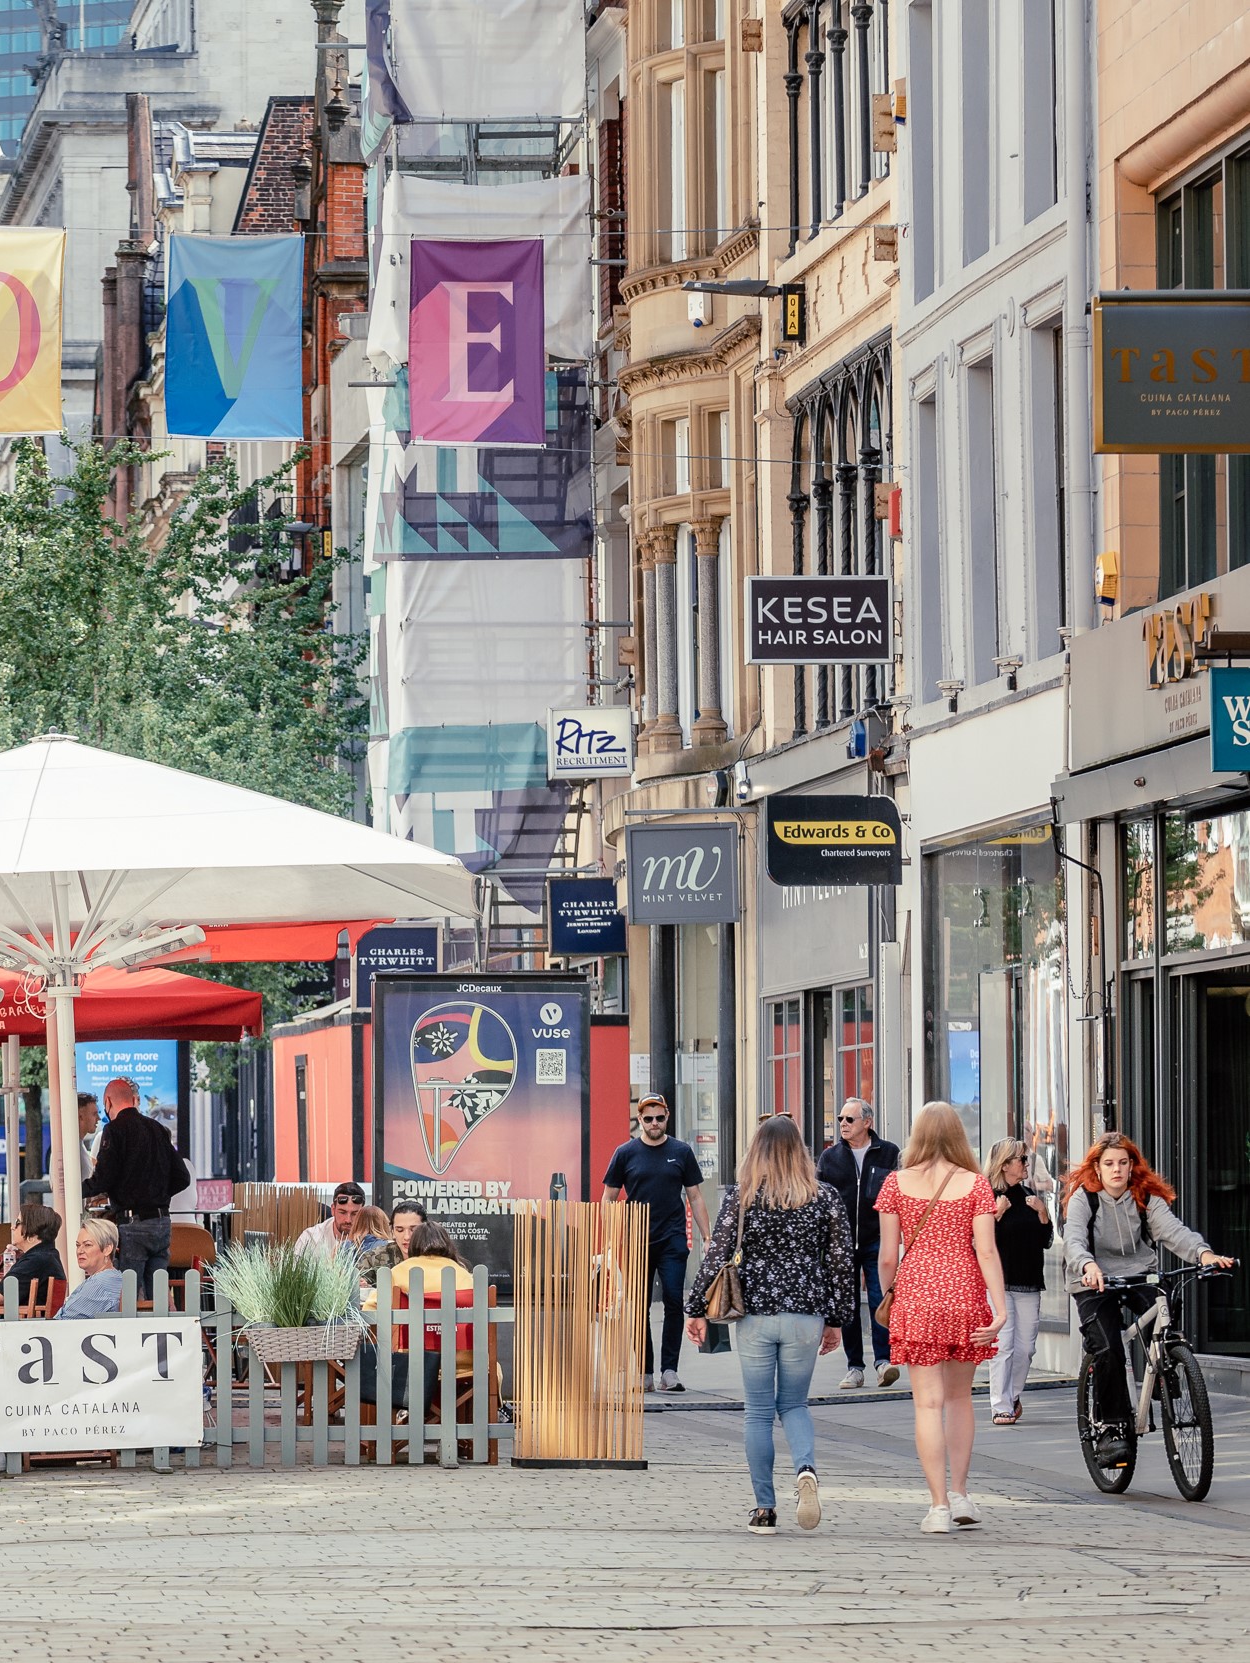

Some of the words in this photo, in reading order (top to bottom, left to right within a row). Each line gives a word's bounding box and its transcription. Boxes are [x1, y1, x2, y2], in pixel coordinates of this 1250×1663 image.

[186, 277, 281, 400] V
[440, 280, 515, 402] E
[1140, 393, 1172, 402] CUINA
[1177, 393, 1231, 402] CATALANA
[1193, 407, 1221, 416] PÉREZ
[757, 596, 882, 624] KESEA
[758, 630, 808, 645] HAIR
[812, 629, 882, 645] SALON
[556, 756, 627, 766] RECRUITMENT
[783, 824, 850, 839] Edwards
[855, 825, 867, 838] &
[872, 825, 891, 838] Co
[821, 848, 855, 857] Chartered
[856, 849, 891, 858] Surveyors
[642, 893, 674, 903] MINT
[678, 892, 723, 902] VELVET
[562, 900, 615, 908] CHARLES
[558, 909, 618, 917] TYRWHITT
[369, 948, 424, 956] CHARLES
[358, 957, 434, 966] TYRWHITT
[456, 984, 502, 993] JCDecaux
[85, 1050, 111, 1061] Don't
[113, 1052, 132, 1063] pay
[133, 1052, 159, 1061] more
[87, 1062, 109, 1072] than
[111, 1063, 133, 1072] next
[135, 1062, 158, 1072] door
[392, 1180, 483, 1197] POWERED
[485, 1181, 512, 1198] BY
[392, 1198, 542, 1215] CLABORATION
[5, 1405, 52, 1417] CUINA
[61, 1402, 141, 1415] CATALANA
[21, 1429, 36, 1437] BY
[44, 1428, 78, 1436] PACO
[85, 1425, 126, 1435] PÉREZ
